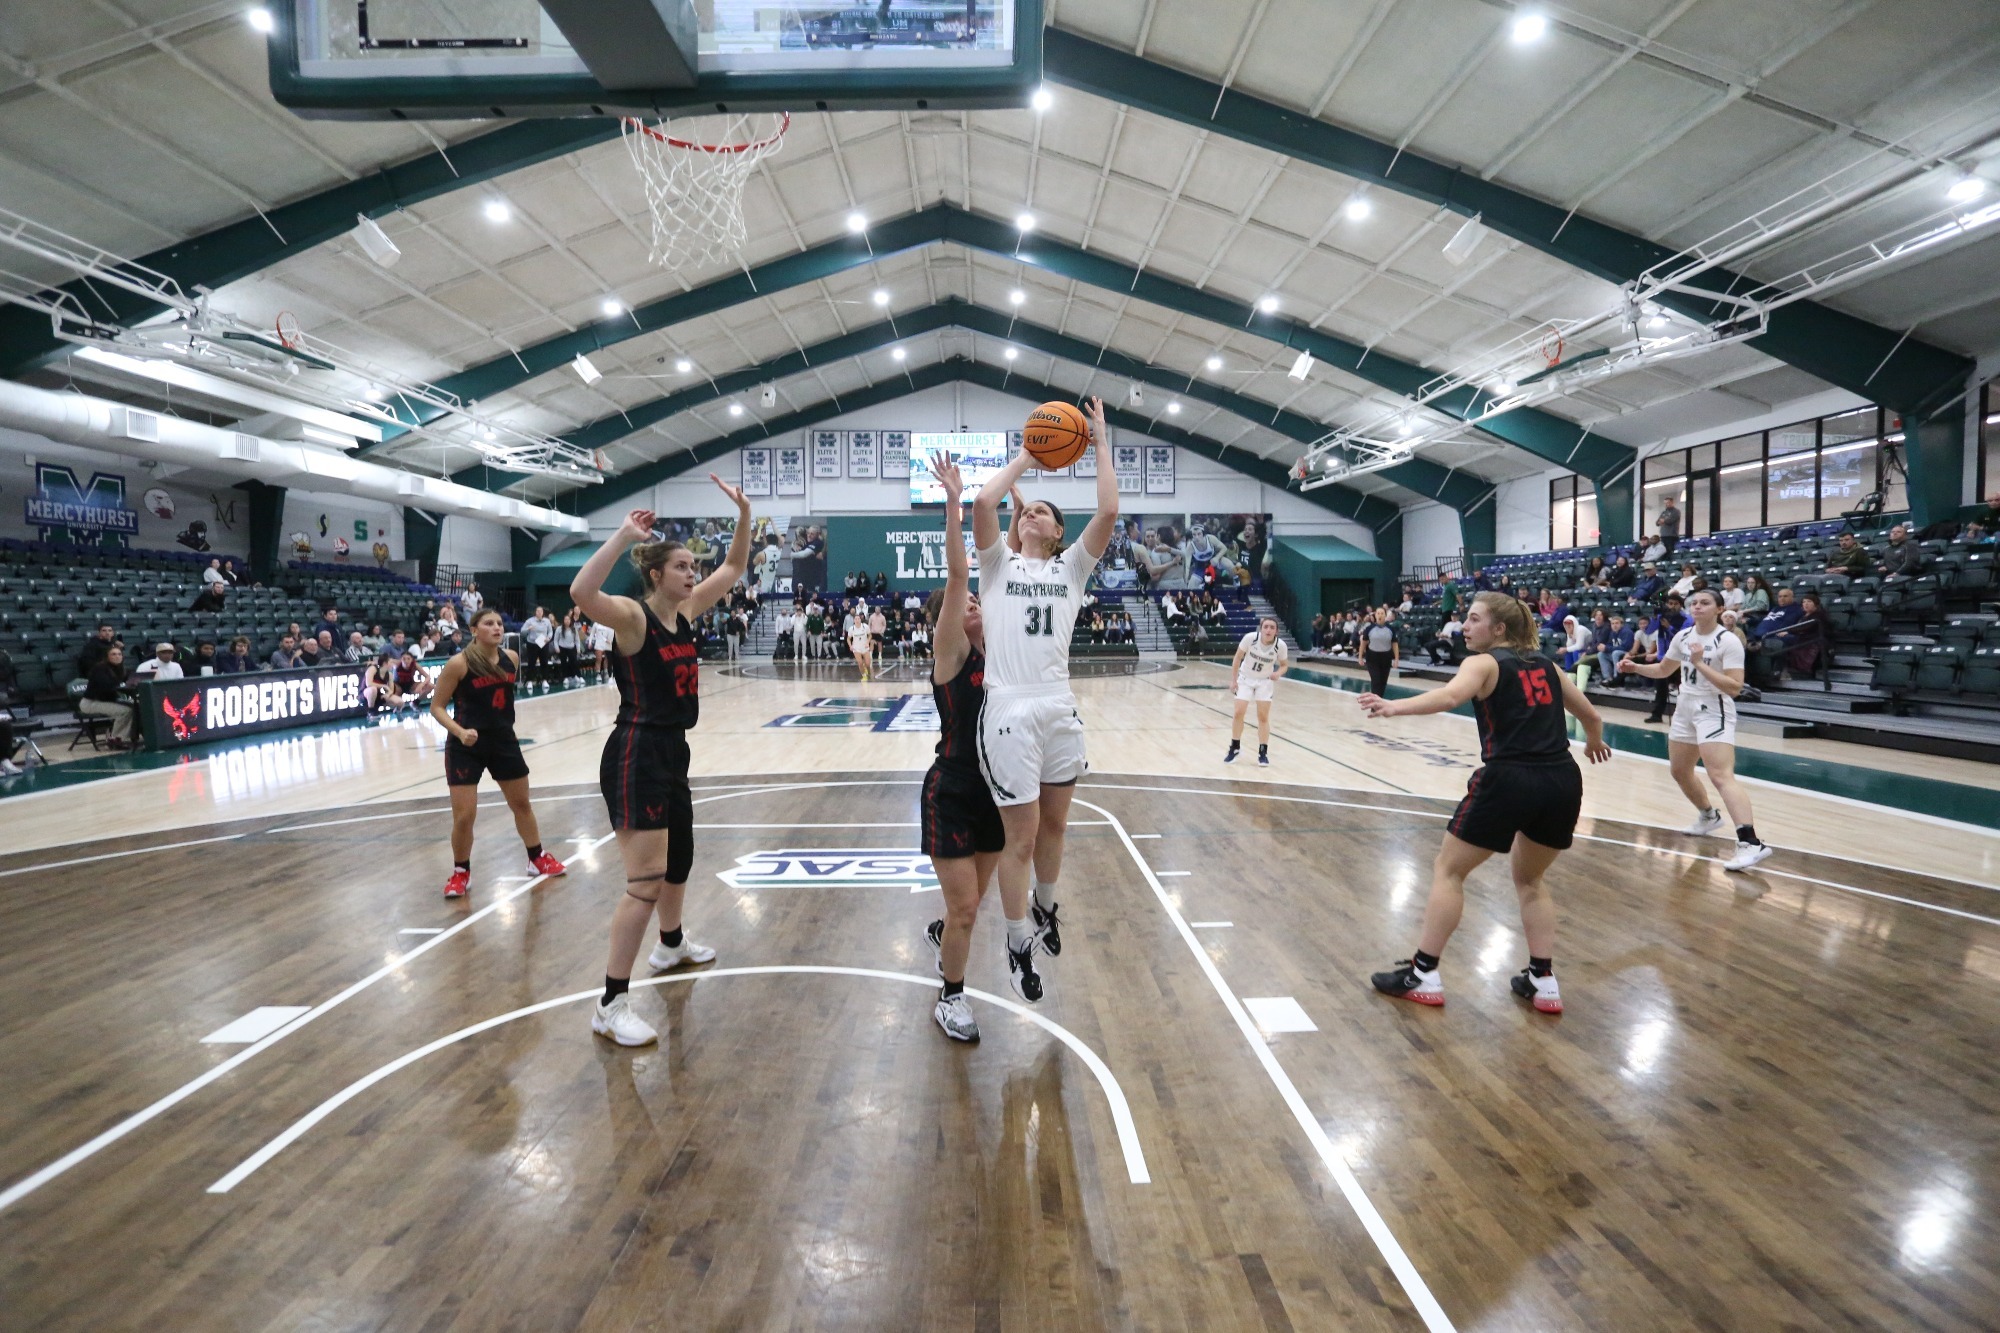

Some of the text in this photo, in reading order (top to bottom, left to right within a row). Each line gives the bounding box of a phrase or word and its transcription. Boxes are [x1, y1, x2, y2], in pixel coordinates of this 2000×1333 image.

[920, 434, 997, 446] MERCYHURST
[27, 498, 137, 529] MERCYHURST
[67, 521, 103, 531] UNIVERSITY
[1005, 580, 1068, 599] MERCYHURST
[1025, 604, 1054, 637] 31
[1251, 662, 1264, 672] 15
[492, 687, 506, 709] 4
[1517, 667, 1553, 707] 15
[206, 678, 314, 730] ROBERTS
